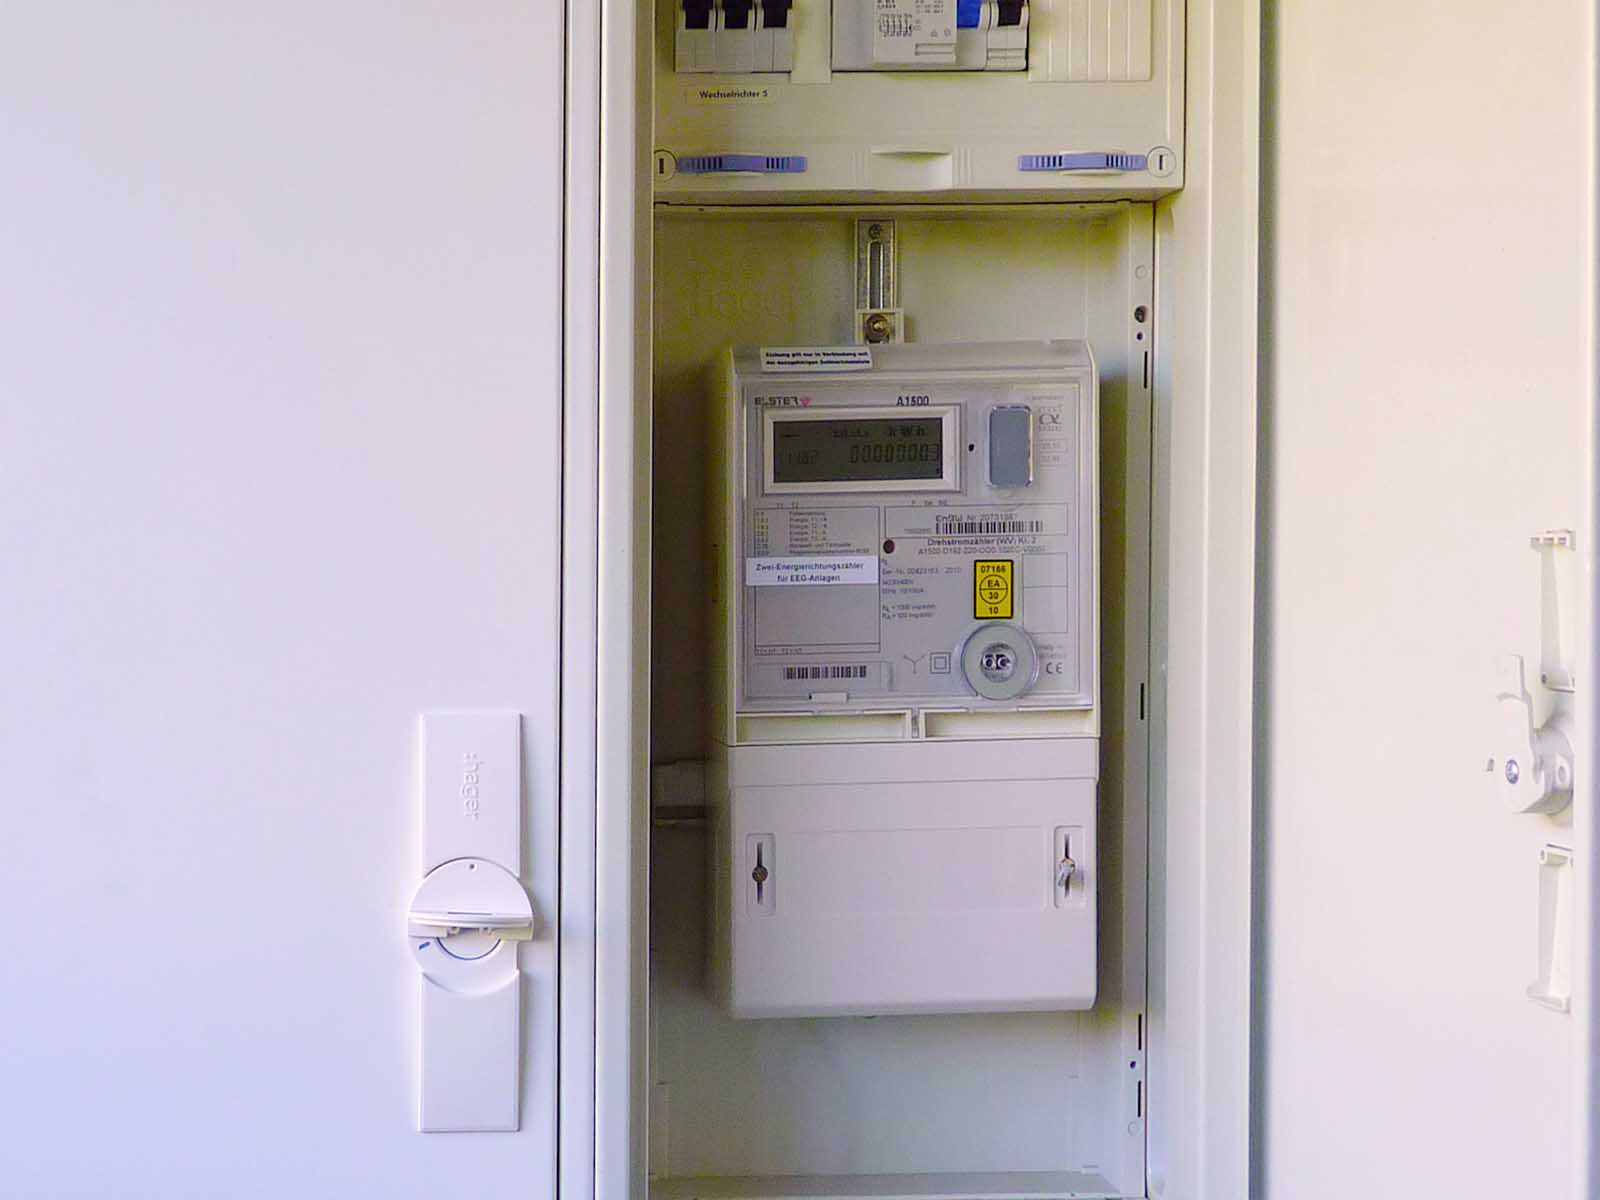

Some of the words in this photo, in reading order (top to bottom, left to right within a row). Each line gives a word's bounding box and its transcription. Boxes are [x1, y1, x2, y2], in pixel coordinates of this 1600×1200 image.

[754, 396, 799, 406] ELSTER
[896, 395, 930, 407] A1500
[755, 562, 864, 573] Zwei-Energierichtungszähler
[777, 574, 789, 583] für
[790, 573, 841, 584] EEG-Anlagen
[987, 579, 1001, 588] EA
[988, 591, 999, 600] 30
[988, 606, 999, 615] 10
